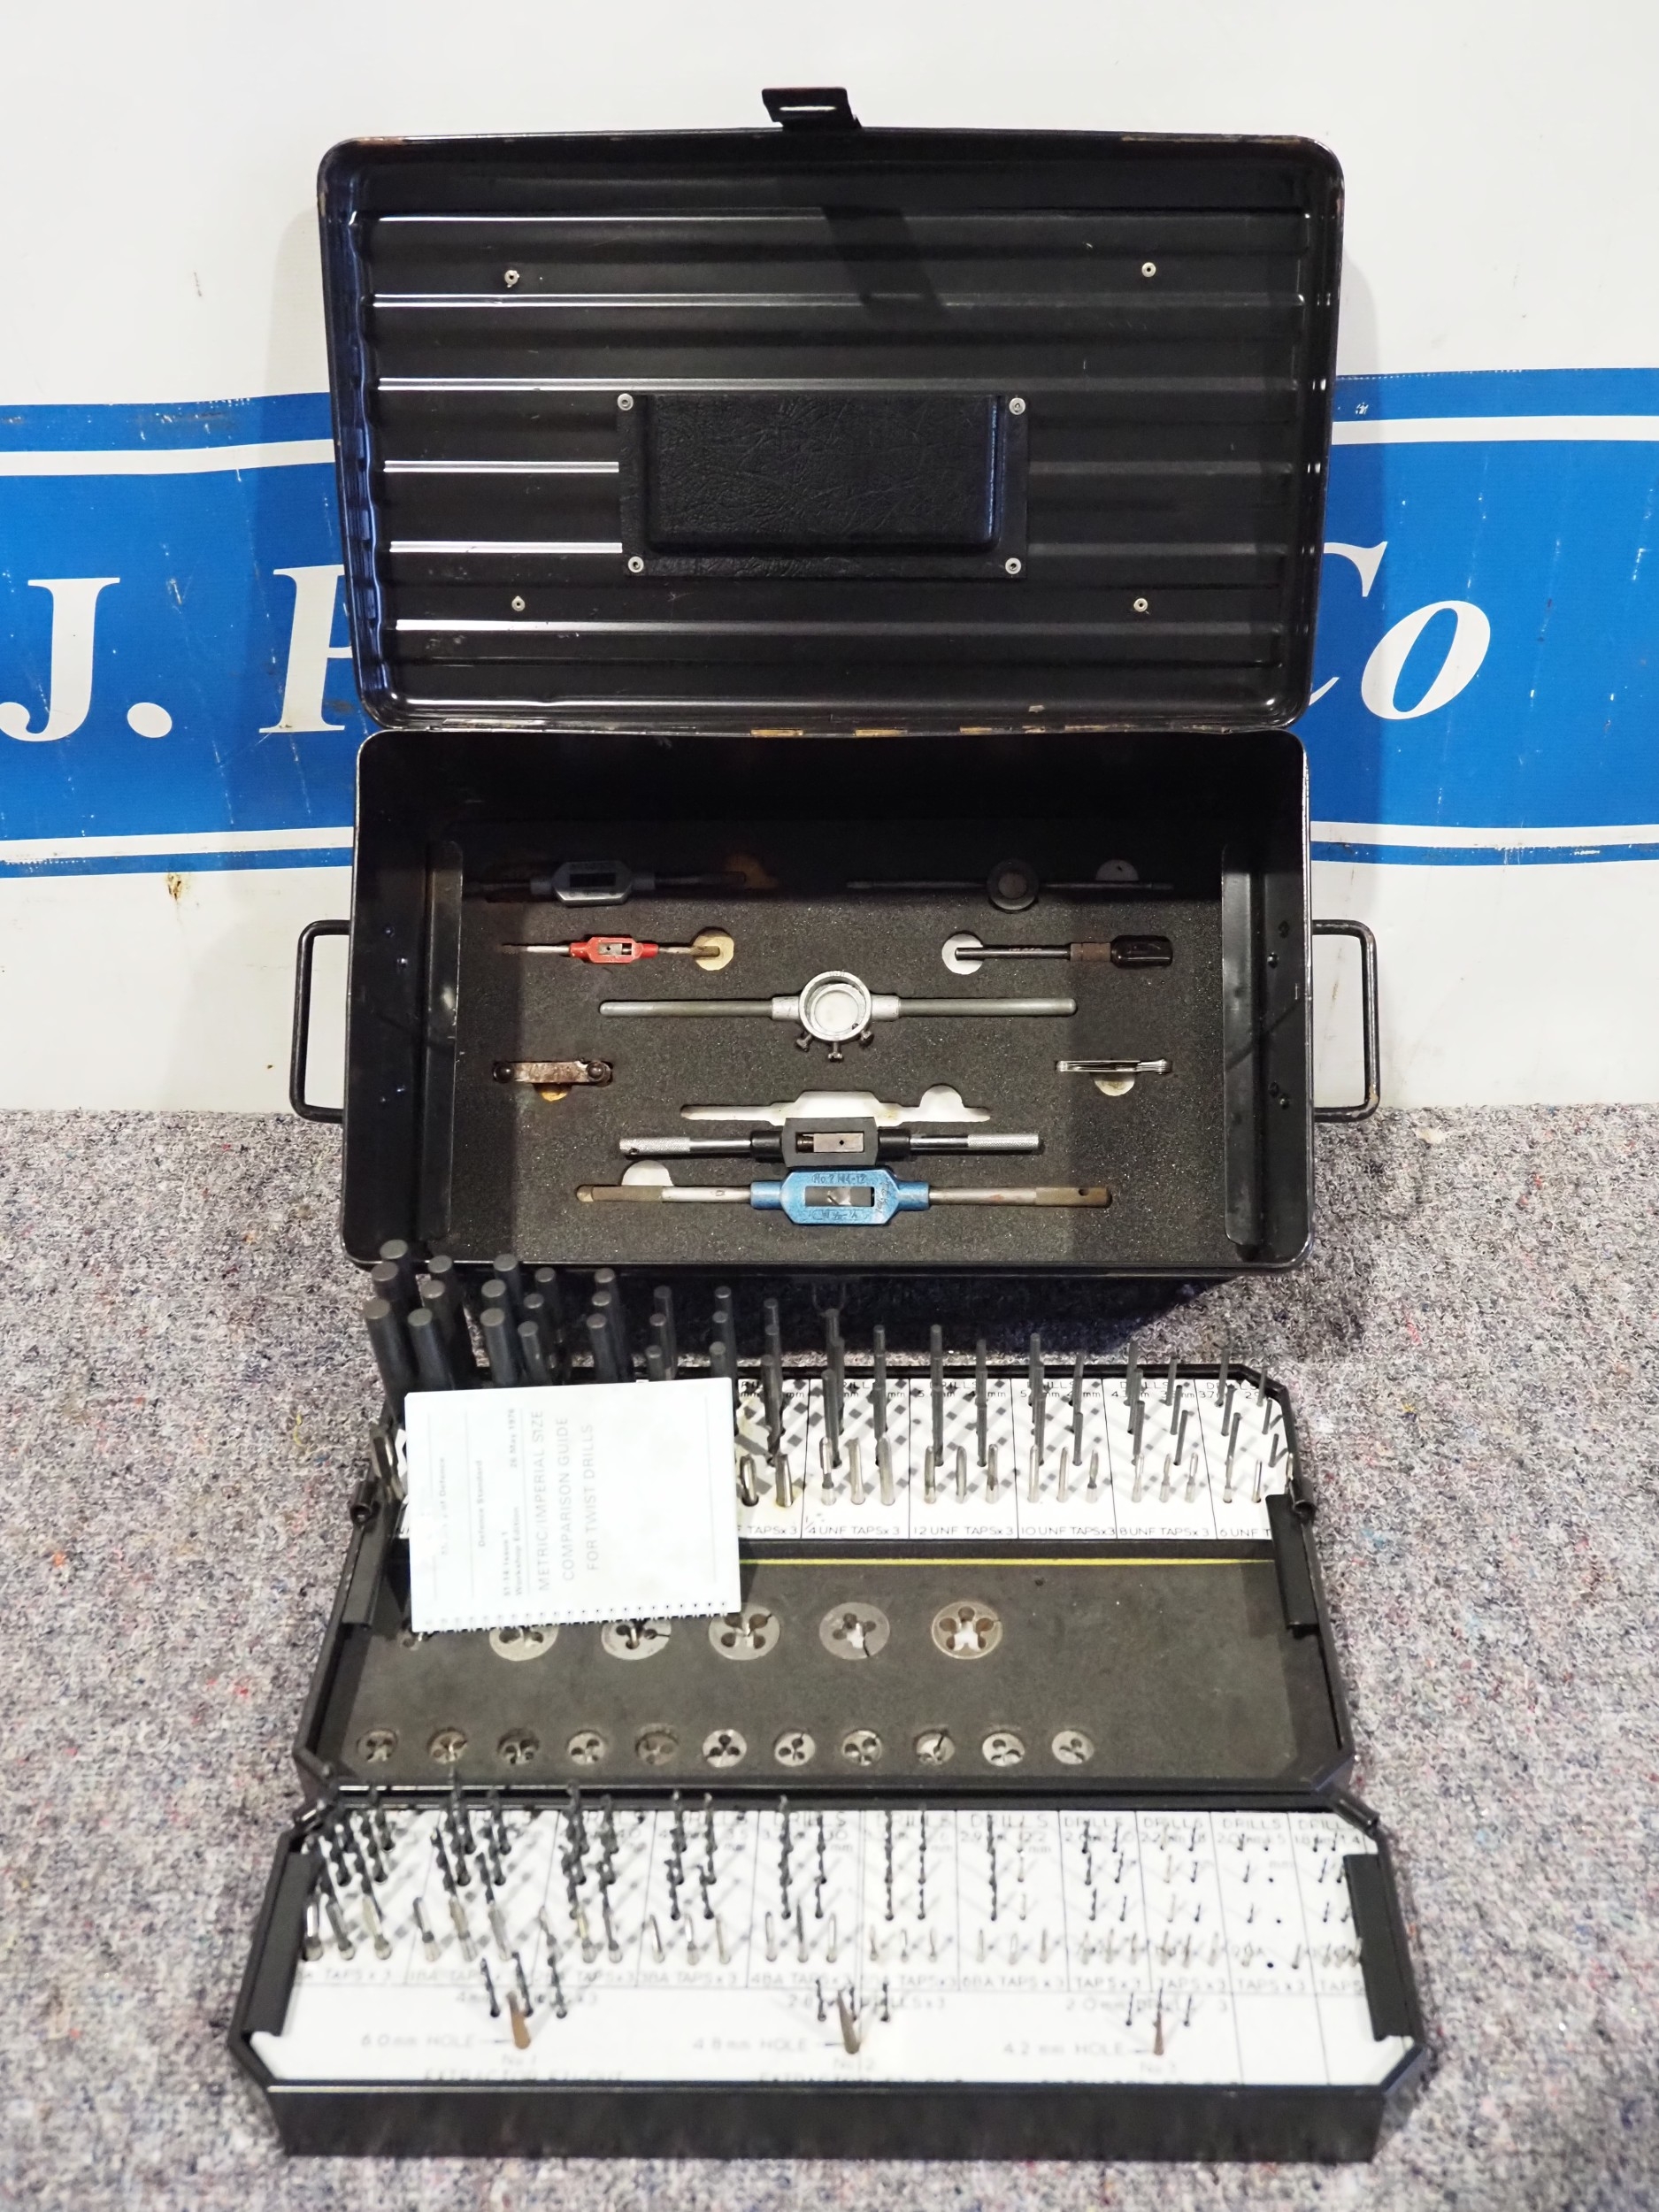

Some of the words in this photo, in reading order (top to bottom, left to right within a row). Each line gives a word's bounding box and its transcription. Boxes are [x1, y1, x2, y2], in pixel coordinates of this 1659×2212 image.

[0, 576, 173, 743] J.
[530, 1409, 544, 1444] SIZE
[556, 1417, 571, 1467] GUIDE
[580, 1423, 595, 1479] DRILLS
[474, 1459, 484, 1505] Standard
[559, 1471, 576, 1582] COMPARISON
[583, 1486, 599, 1534] TWIST
[586, 1539, 601, 1571] FOR
[1223, 1818, 1282, 1830] DRILLS
[426, 2033, 474, 2048] HOLE
[759, 2036, 807, 2052] HOLE
[1074, 2041, 1124, 2056] HOLE
